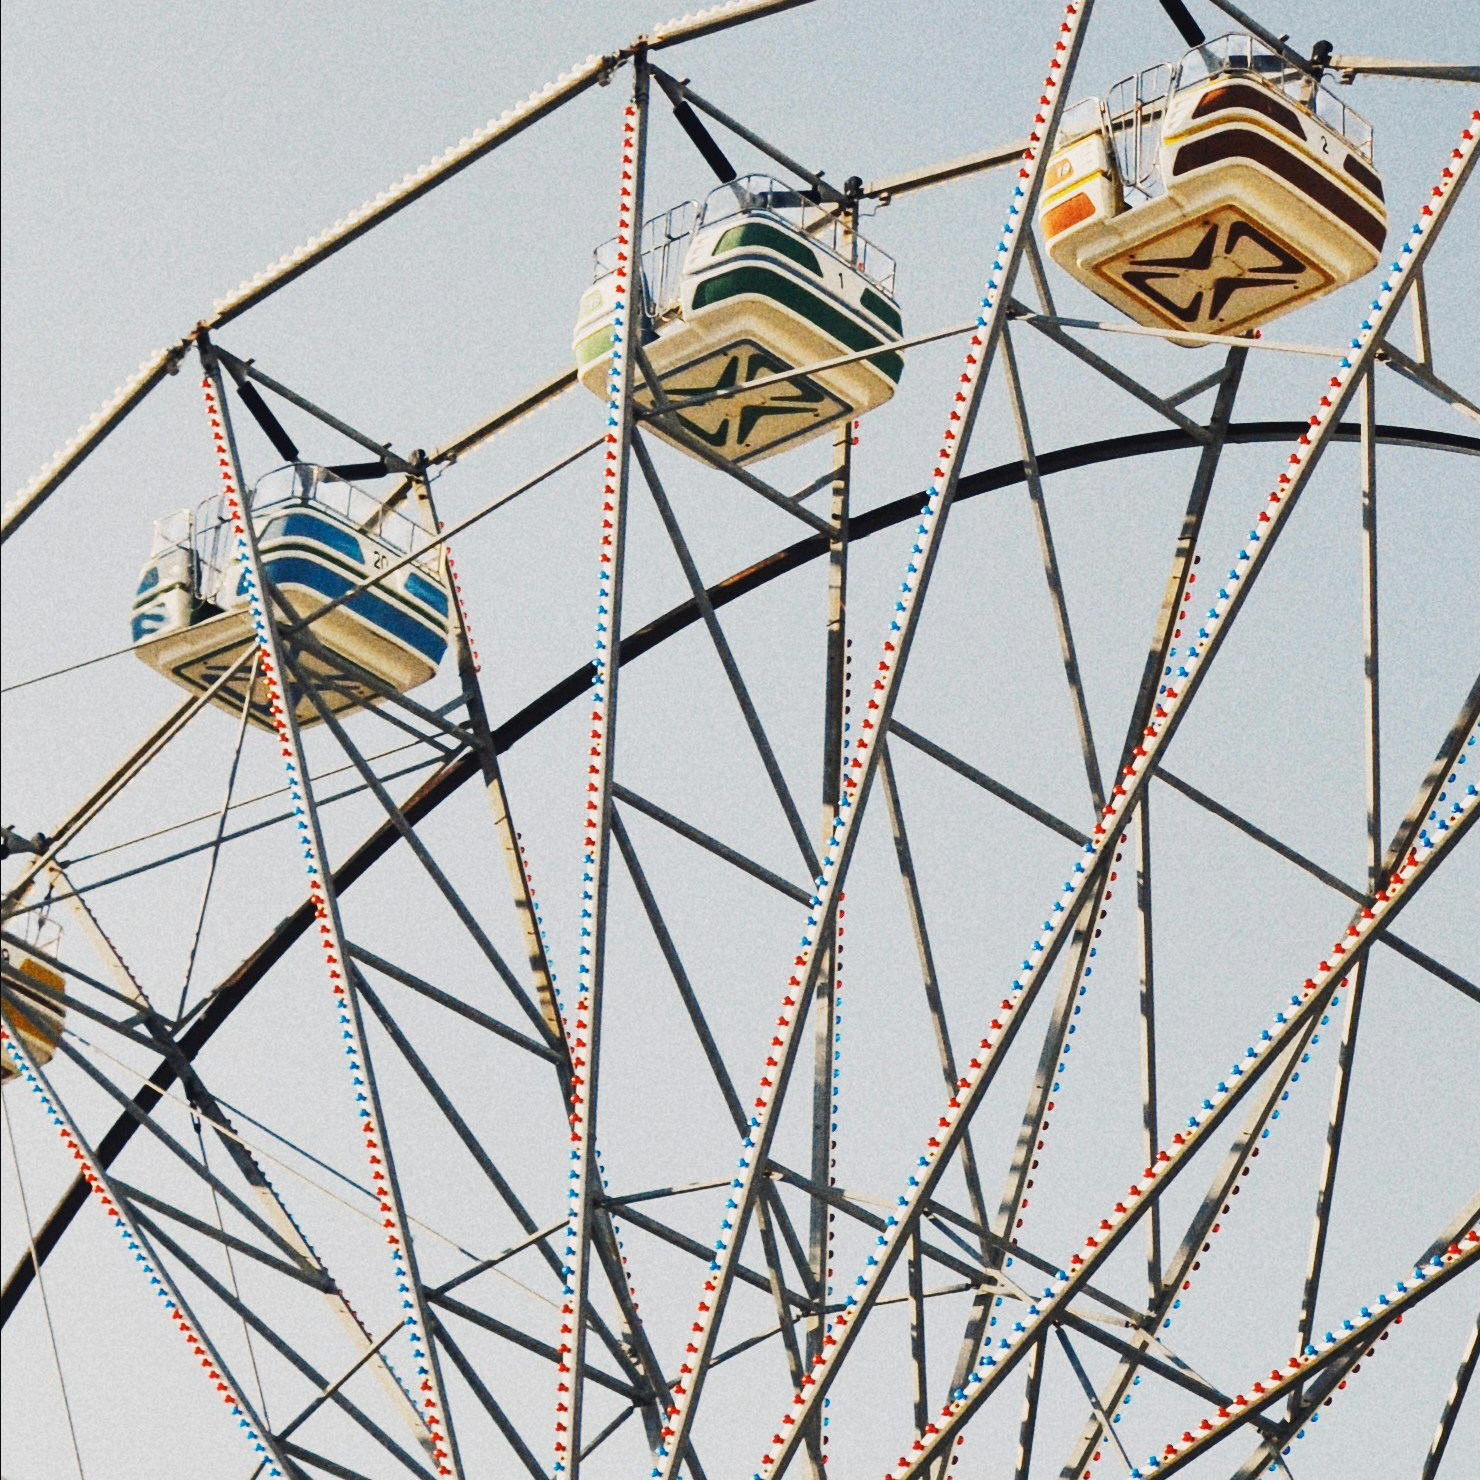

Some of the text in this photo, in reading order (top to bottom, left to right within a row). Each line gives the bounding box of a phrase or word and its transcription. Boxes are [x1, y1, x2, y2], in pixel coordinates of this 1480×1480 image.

[1320, 135, 1329, 155] 2
[838, 272, 844, 290] 1
[373, 550, 389, 570] 20
